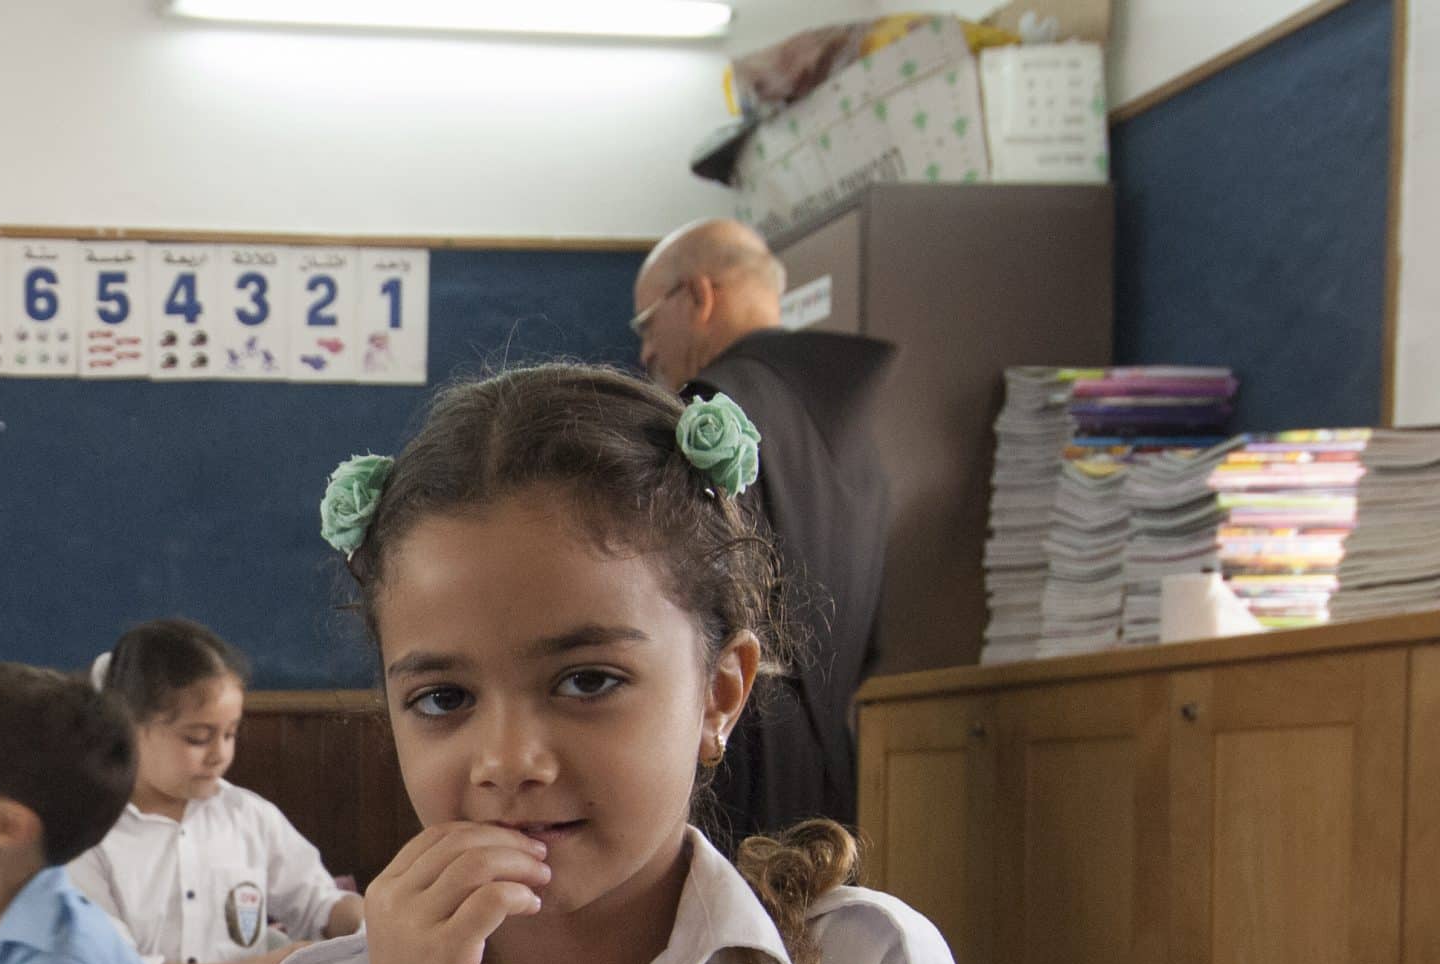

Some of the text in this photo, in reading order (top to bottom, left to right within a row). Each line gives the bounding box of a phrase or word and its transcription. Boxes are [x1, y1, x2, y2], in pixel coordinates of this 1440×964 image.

[24, 267, 59, 321] 6
[96, 271, 131, 325] 5
[164, 271, 203, 324] 4
[234, 271, 271, 327] 3
[305, 274, 338, 326] 2
[379, 276, 403, 329] 1
